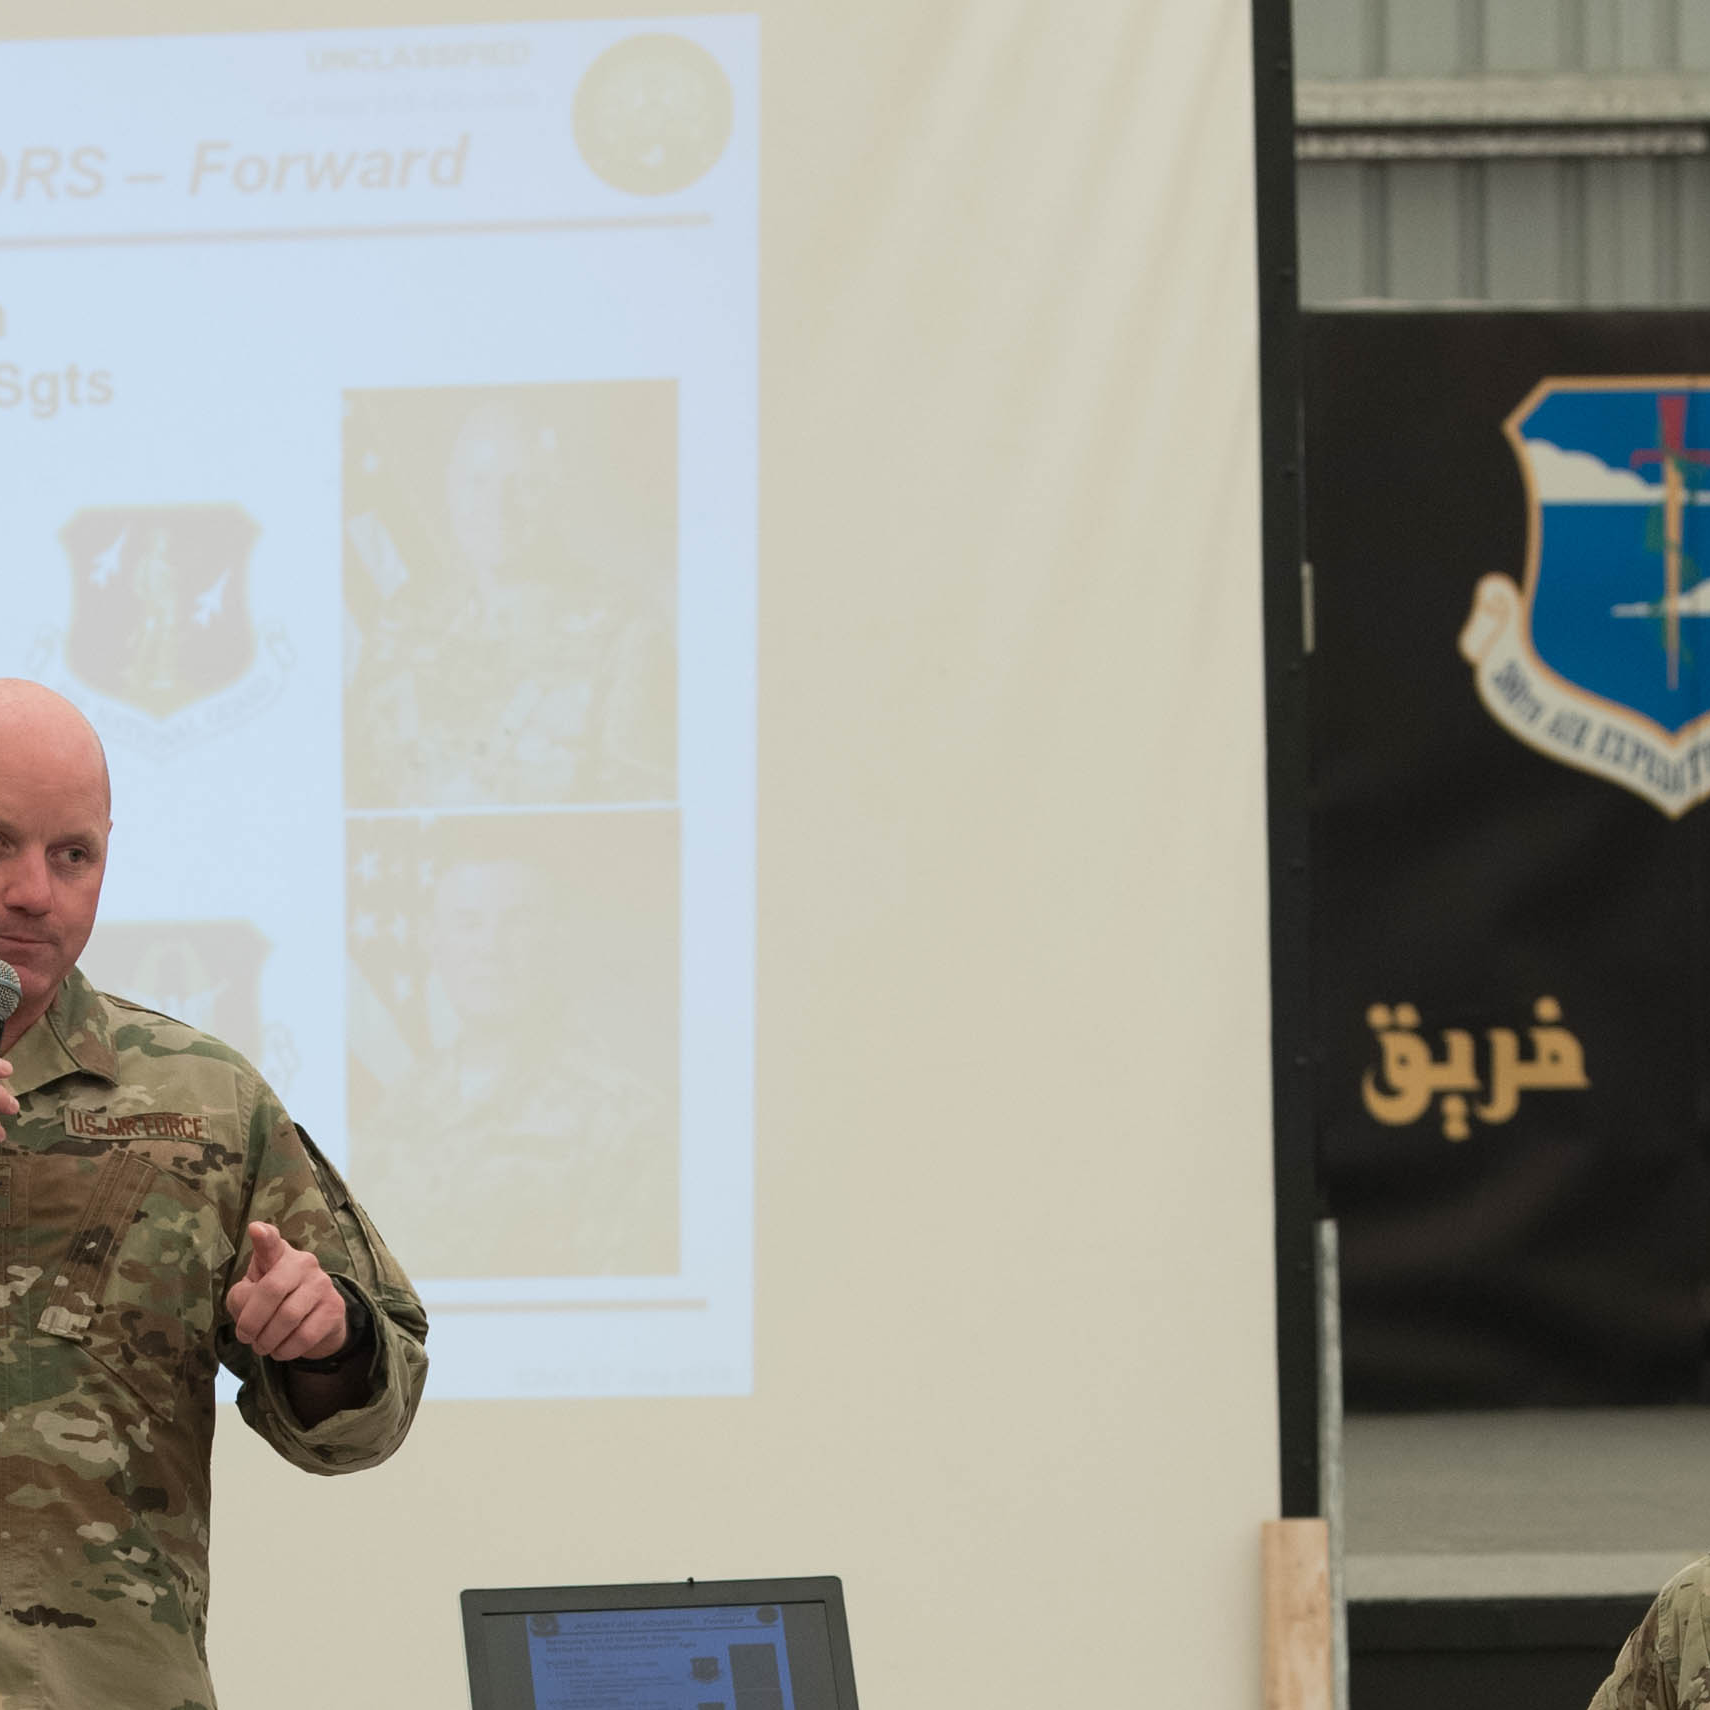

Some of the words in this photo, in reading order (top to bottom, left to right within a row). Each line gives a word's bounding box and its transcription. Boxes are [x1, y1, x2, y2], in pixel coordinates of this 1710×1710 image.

[188, 132, 472, 197] Forward
[1362, 997, 1591, 1141] فريق
[106, 1117, 140, 1136] AIR
[144, 1115, 202, 1140] FORCE
